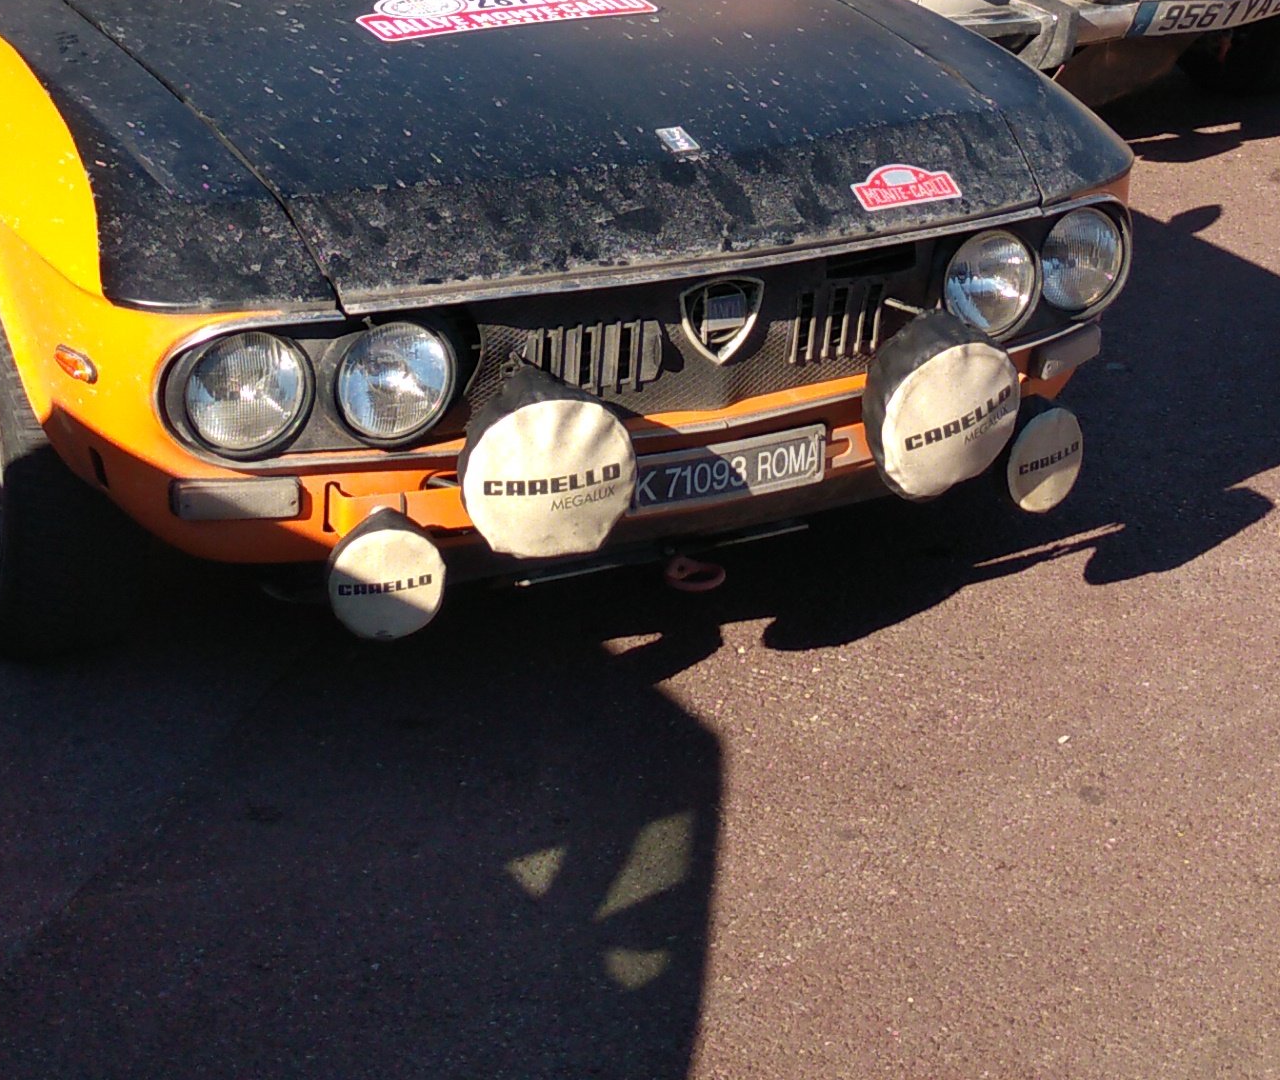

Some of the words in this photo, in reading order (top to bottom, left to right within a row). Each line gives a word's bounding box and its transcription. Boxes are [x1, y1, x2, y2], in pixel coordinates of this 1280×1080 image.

[368, 15, 468, 37] RALLYE
[1159, 0, 1236, 31] 9561
[861, 176, 952, 206] MONTE-CARLO
[905, 385, 1011, 451] CARELLO
[964, 406, 1009, 446] MEGALUX
[665, 456, 748, 498] 71093
[758, 441, 819, 481] ROMA
[1019, 440, 1079, 475] CARELLO
[484, 463, 621, 496] CARELLO
[551, 485, 617, 512] MEGALUX
[338, 574, 433, 596] CARELLO
